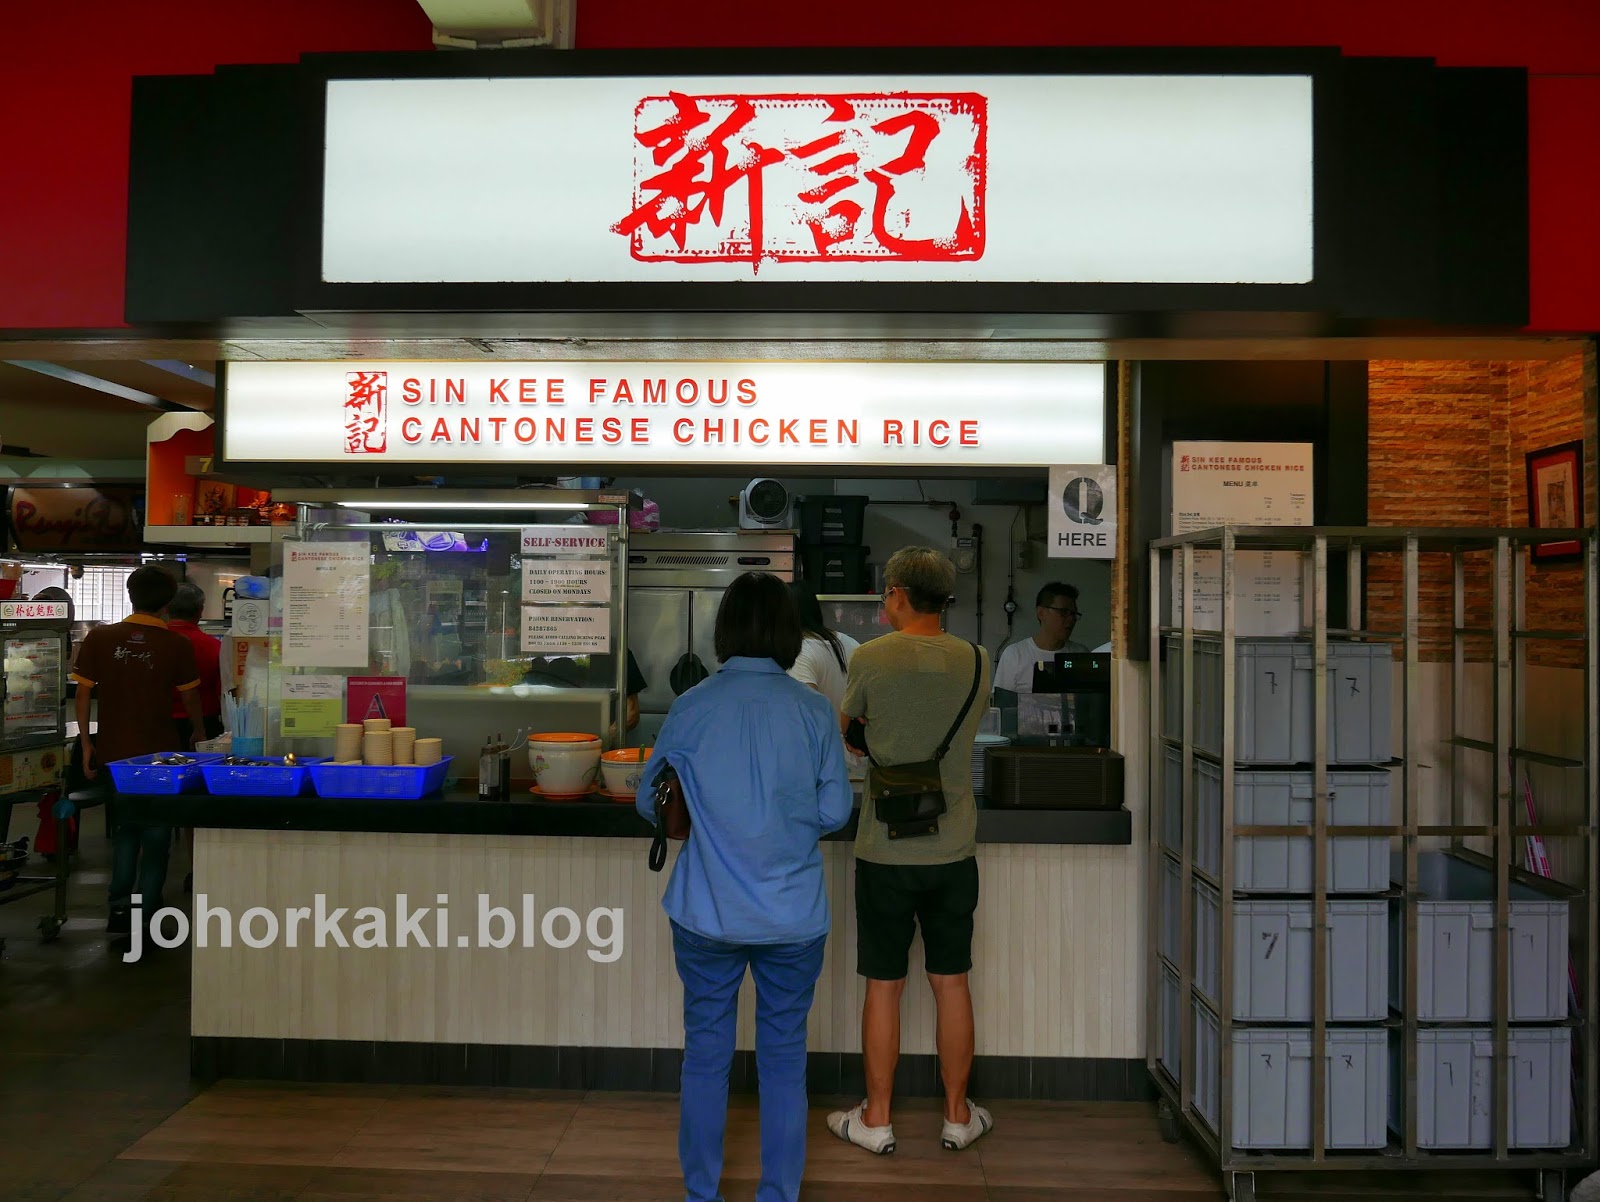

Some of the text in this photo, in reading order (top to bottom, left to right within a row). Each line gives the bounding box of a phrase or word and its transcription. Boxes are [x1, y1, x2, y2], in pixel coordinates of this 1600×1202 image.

[608, 91, 976, 275] 新記
[401, 378, 758, 405] SIN KEE FAMOUS
[343, 372, 387, 452] 新記
[401, 417, 980, 446] CANTONESE CHICKEN RICE
[199, 457, 212, 473] 7
[1063, 477, 1104, 525] Q
[523, 537, 606, 548] SELF-SERVICE
[1058, 532, 1107, 546] HERE
[362, 692, 388, 720] A
